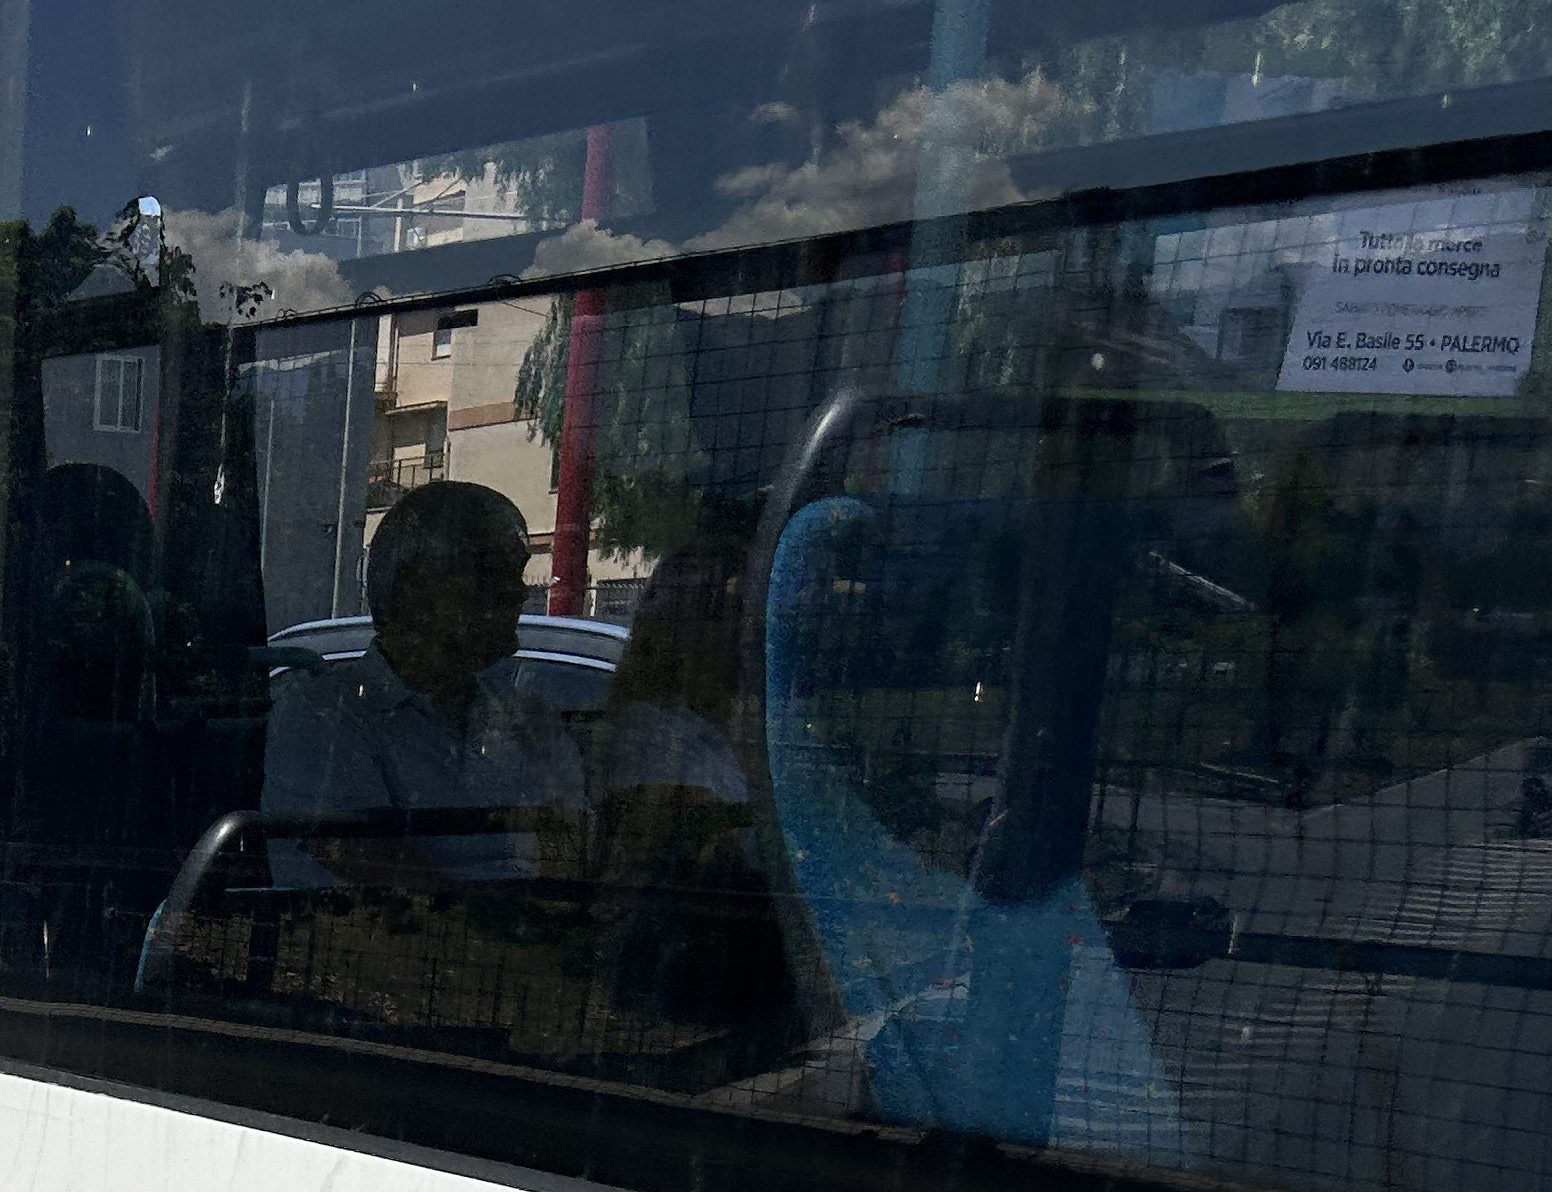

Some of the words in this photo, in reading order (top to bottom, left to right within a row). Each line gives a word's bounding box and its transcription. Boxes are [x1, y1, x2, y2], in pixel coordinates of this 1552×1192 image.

[1353, 255, 1412, 277] pronta
[1416, 259, 1501, 281] consegna
[1306, 330, 1332, 349] Via
[1335, 332, 1352, 349] E.
[1355, 331, 1401, 350] Basile
[1404, 333, 1425, 351] 55
[1439, 334, 1521, 354] PALERMO
[1302, 356, 1327, 371] 091
